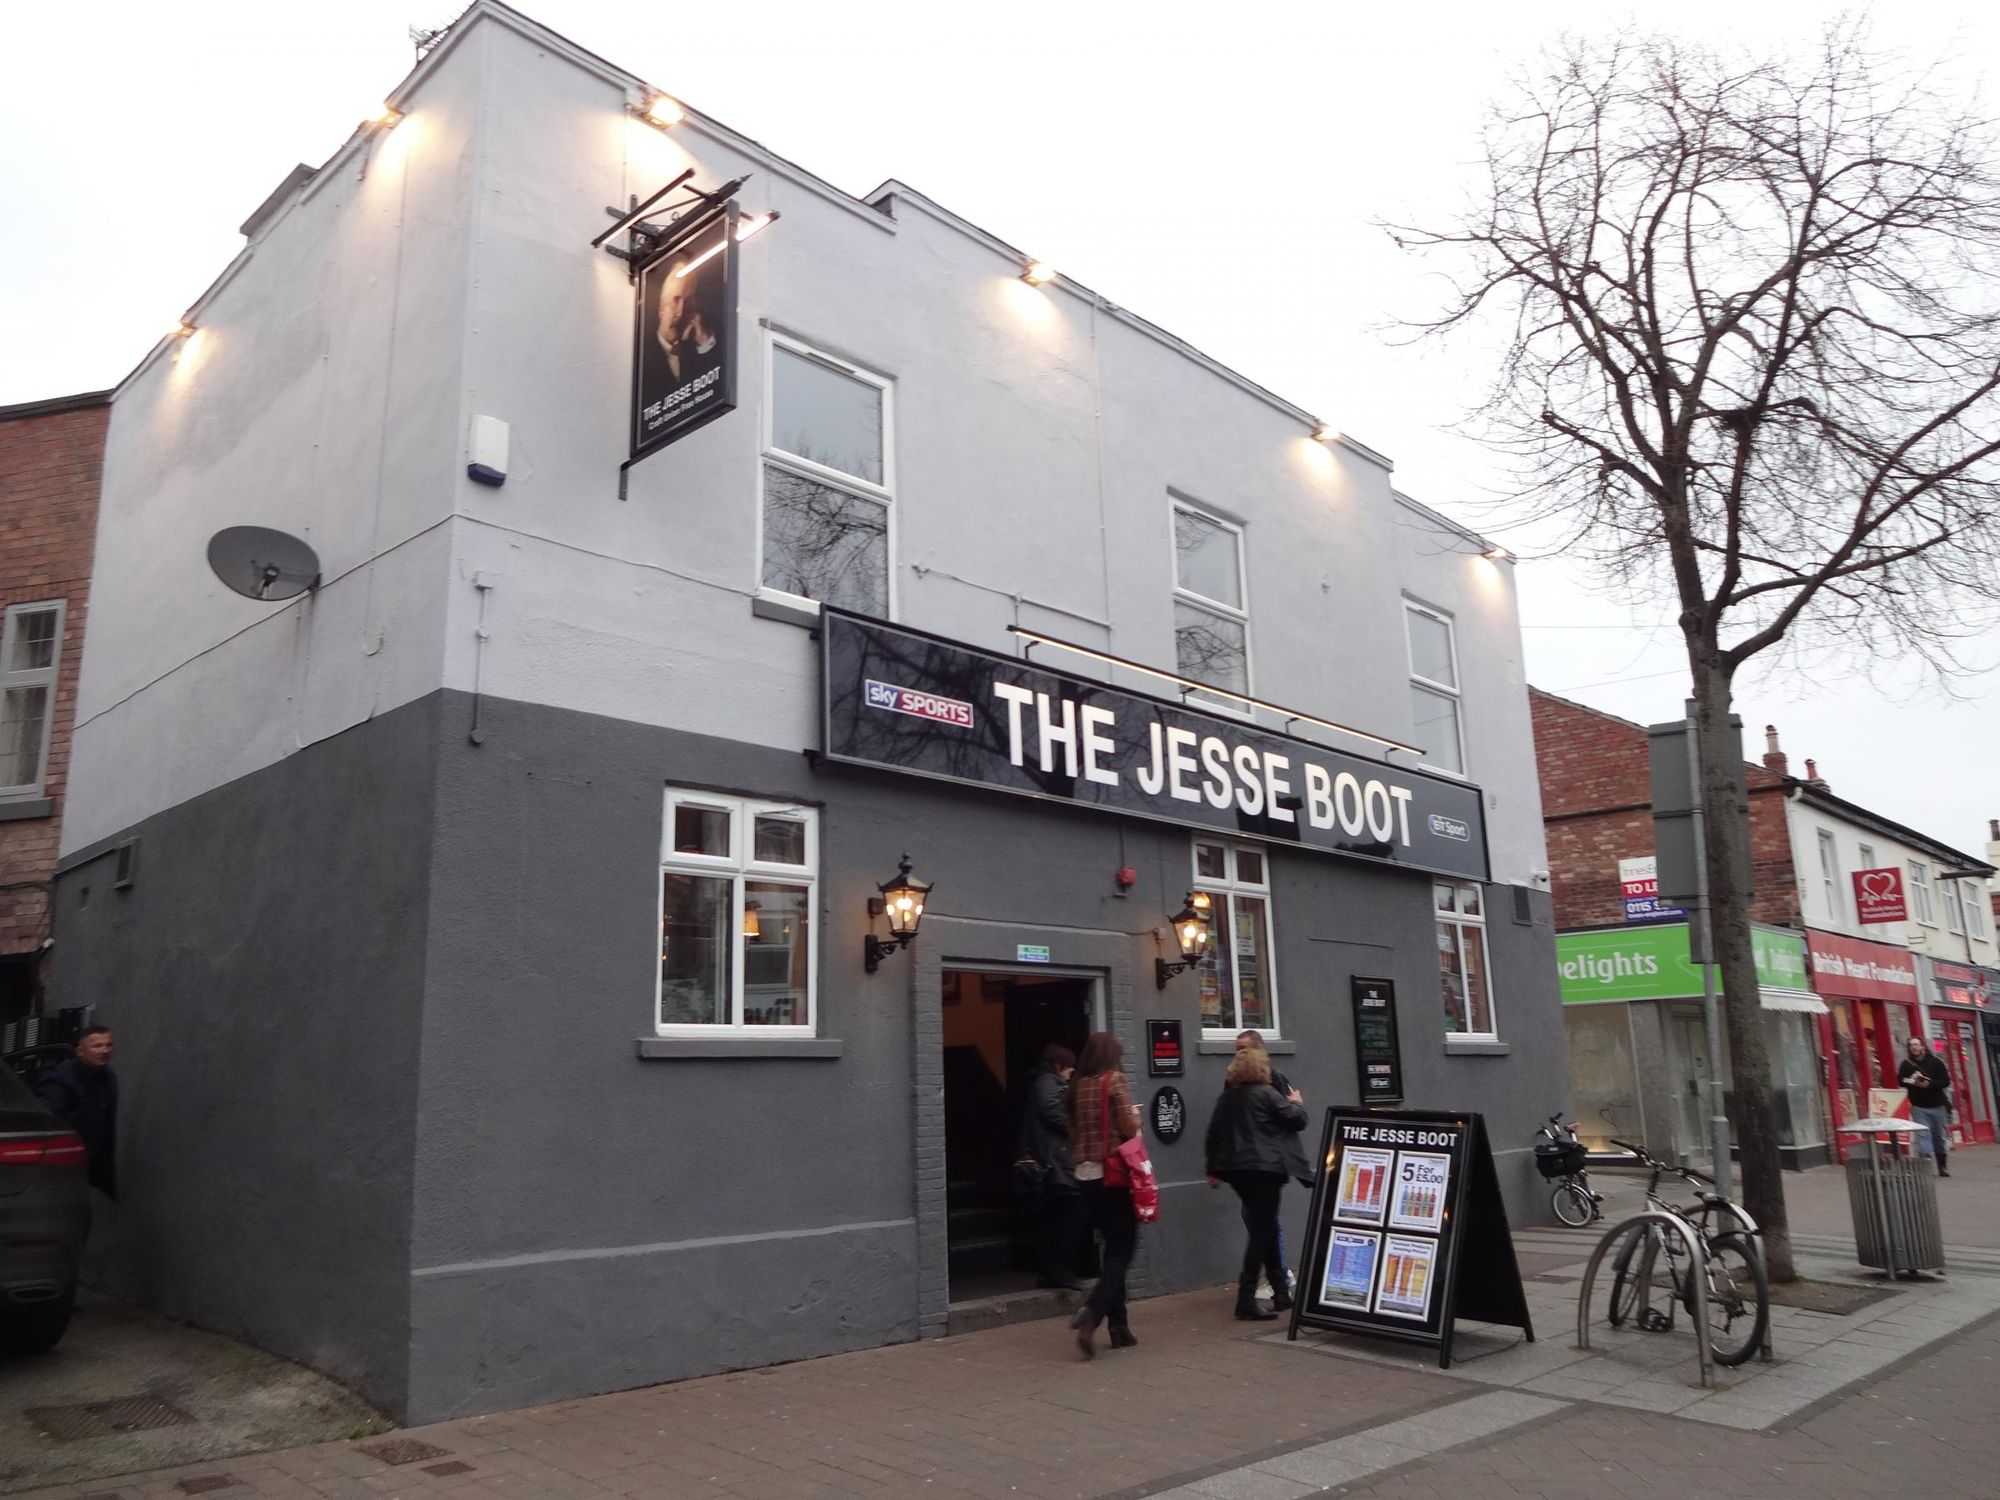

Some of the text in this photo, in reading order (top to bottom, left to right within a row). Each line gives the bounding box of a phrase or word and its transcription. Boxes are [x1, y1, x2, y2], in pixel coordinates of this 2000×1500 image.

[643, 366, 721, 421] THE JESSE BOOT
[870, 686, 970, 723] sky SPORTS
[994, 682, 1412, 847] THE JESSE BOOT
[1445, 821, 1466, 836] Sport
[1624, 881, 1658, 894] TO LE
[1557, 952, 1659, 984] elights
[1812, 951, 1845, 976] British
[1844, 957, 1871, 980] Heart
[1869, 961, 1916, 986] Foundation
[1343, 1126, 1457, 1147] THE JESSE BOOT
[1402, 1162, 1434, 1182] 5 For
[1416, 1174, 1443, 1184] £5.00
